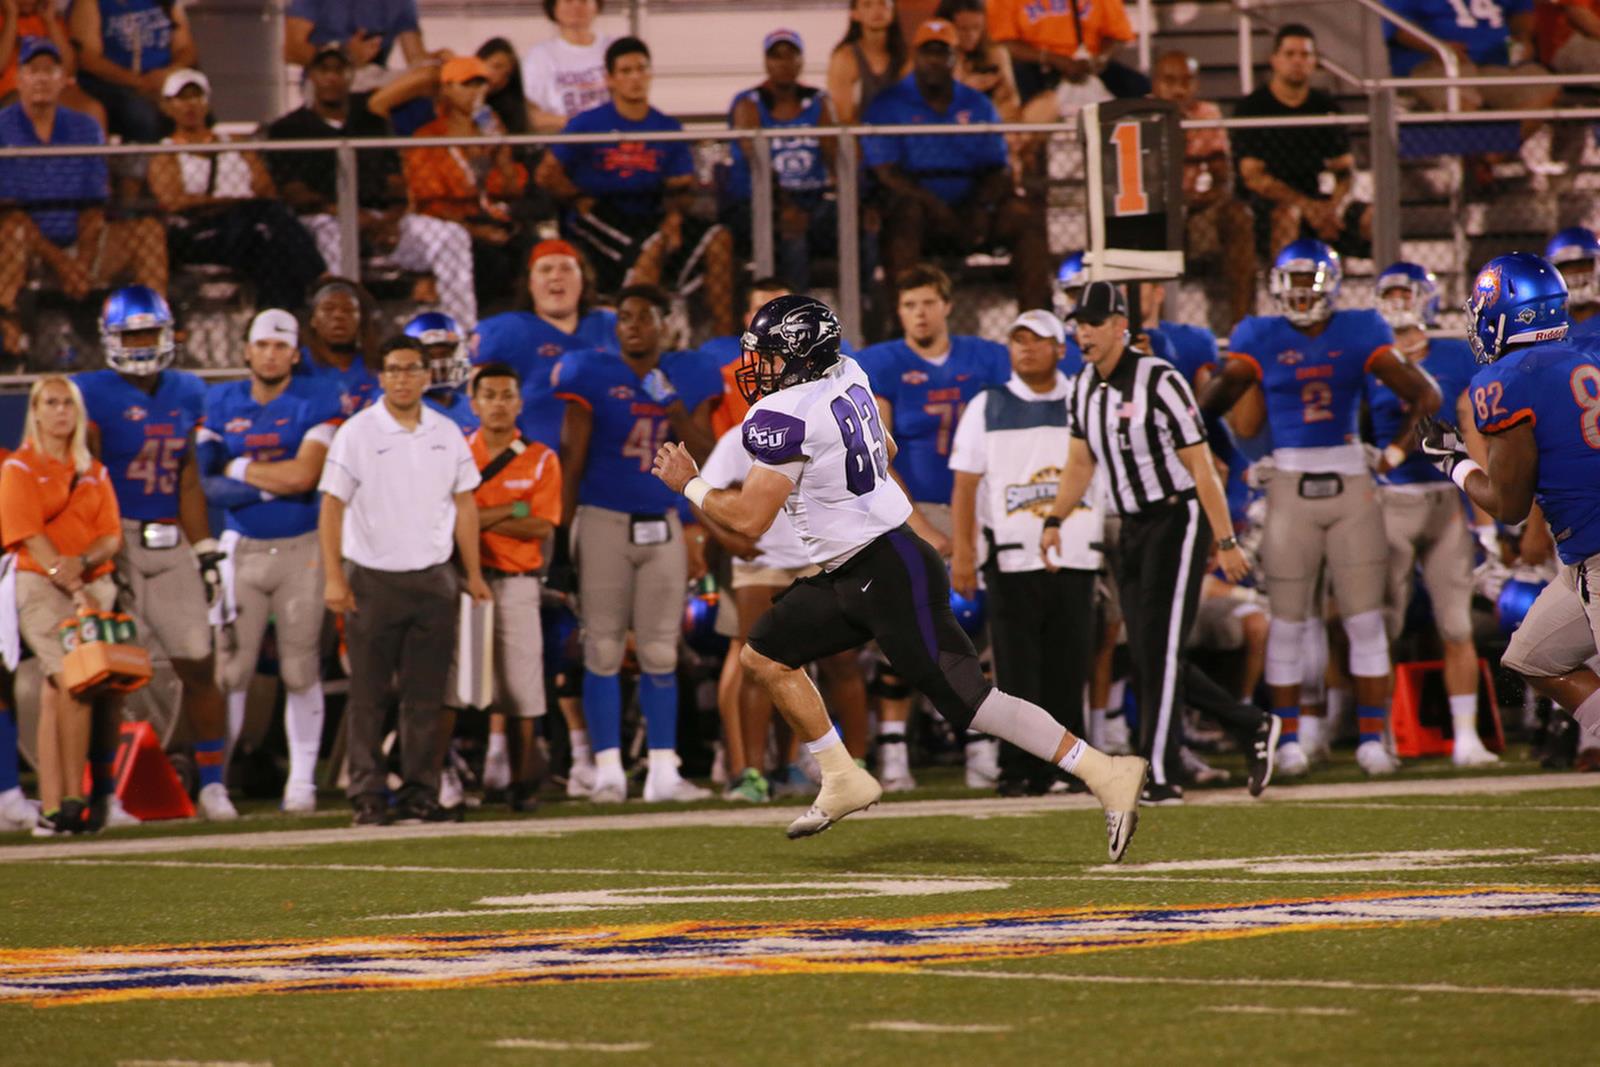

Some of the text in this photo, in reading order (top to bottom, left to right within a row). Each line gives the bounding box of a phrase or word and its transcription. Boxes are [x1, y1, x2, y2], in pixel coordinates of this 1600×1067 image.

[1109, 121, 1149, 216] 1
[1302, 381, 1334, 424] 2
[1475, 381, 1509, 420] 82
[748, 424, 788, 449] ACU
[830, 383, 889, 497] 83
[923, 403, 966, 455] 7
[126, 438, 187, 495] 45
